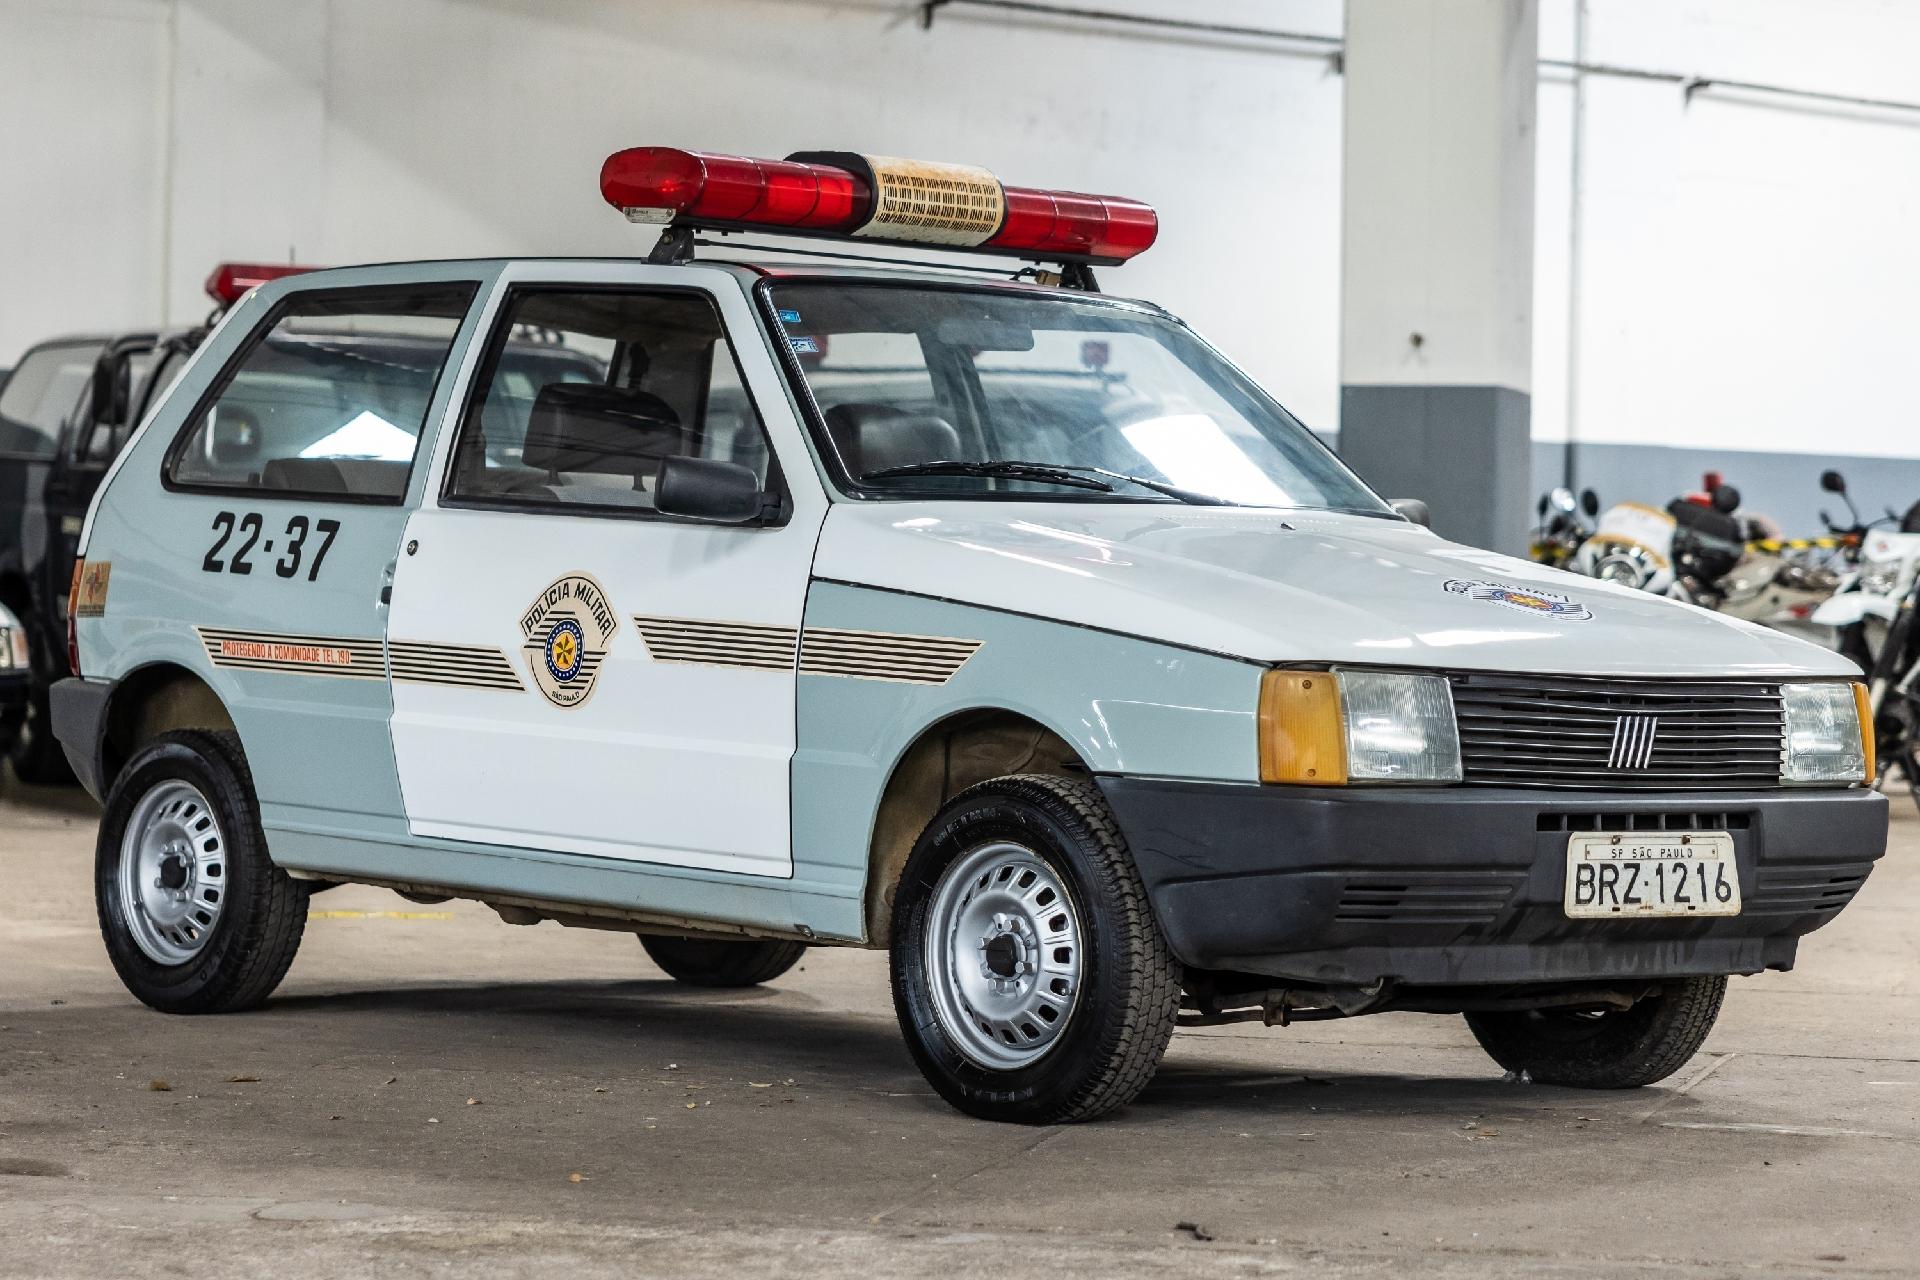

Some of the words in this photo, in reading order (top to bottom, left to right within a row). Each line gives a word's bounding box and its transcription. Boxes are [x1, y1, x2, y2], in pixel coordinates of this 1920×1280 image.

[573, 582, 612, 636] MILITAR
[222, 641, 266, 658] PROTEGENDO
[274, 646, 320, 662] COMUNIDADE
[1611, 848, 1624, 859] SP
[1632, 846, 1652, 859] SÃO
[1660, 848, 1693, 859] PAULO
